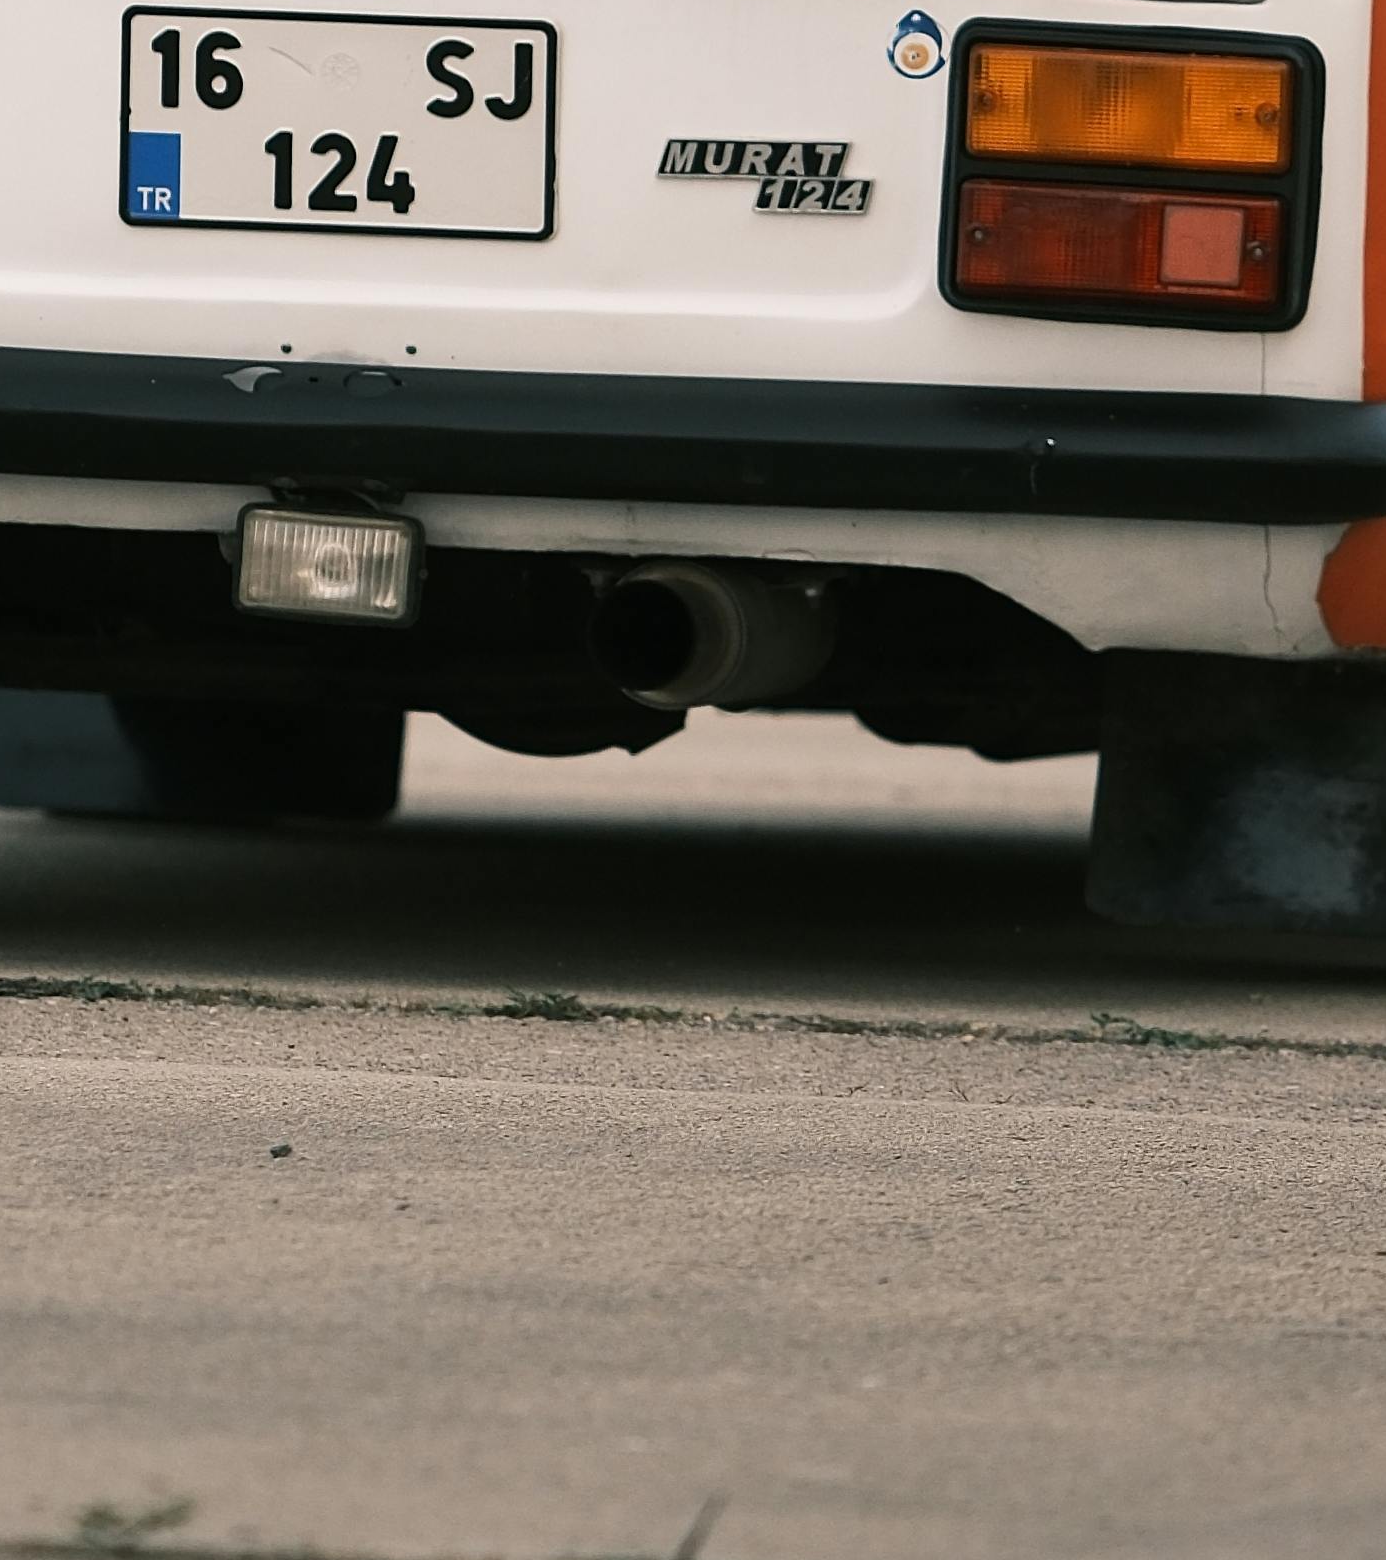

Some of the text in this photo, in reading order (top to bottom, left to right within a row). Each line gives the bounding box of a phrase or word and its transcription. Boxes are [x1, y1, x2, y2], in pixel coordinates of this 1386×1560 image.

[150, 28, 535, 121] 16 SJ
[263, 131, 416, 215] 124
[662, 140, 845, 177] MURAT
[137, 185, 173, 213] TR
[763, 178, 864, 211] 124
